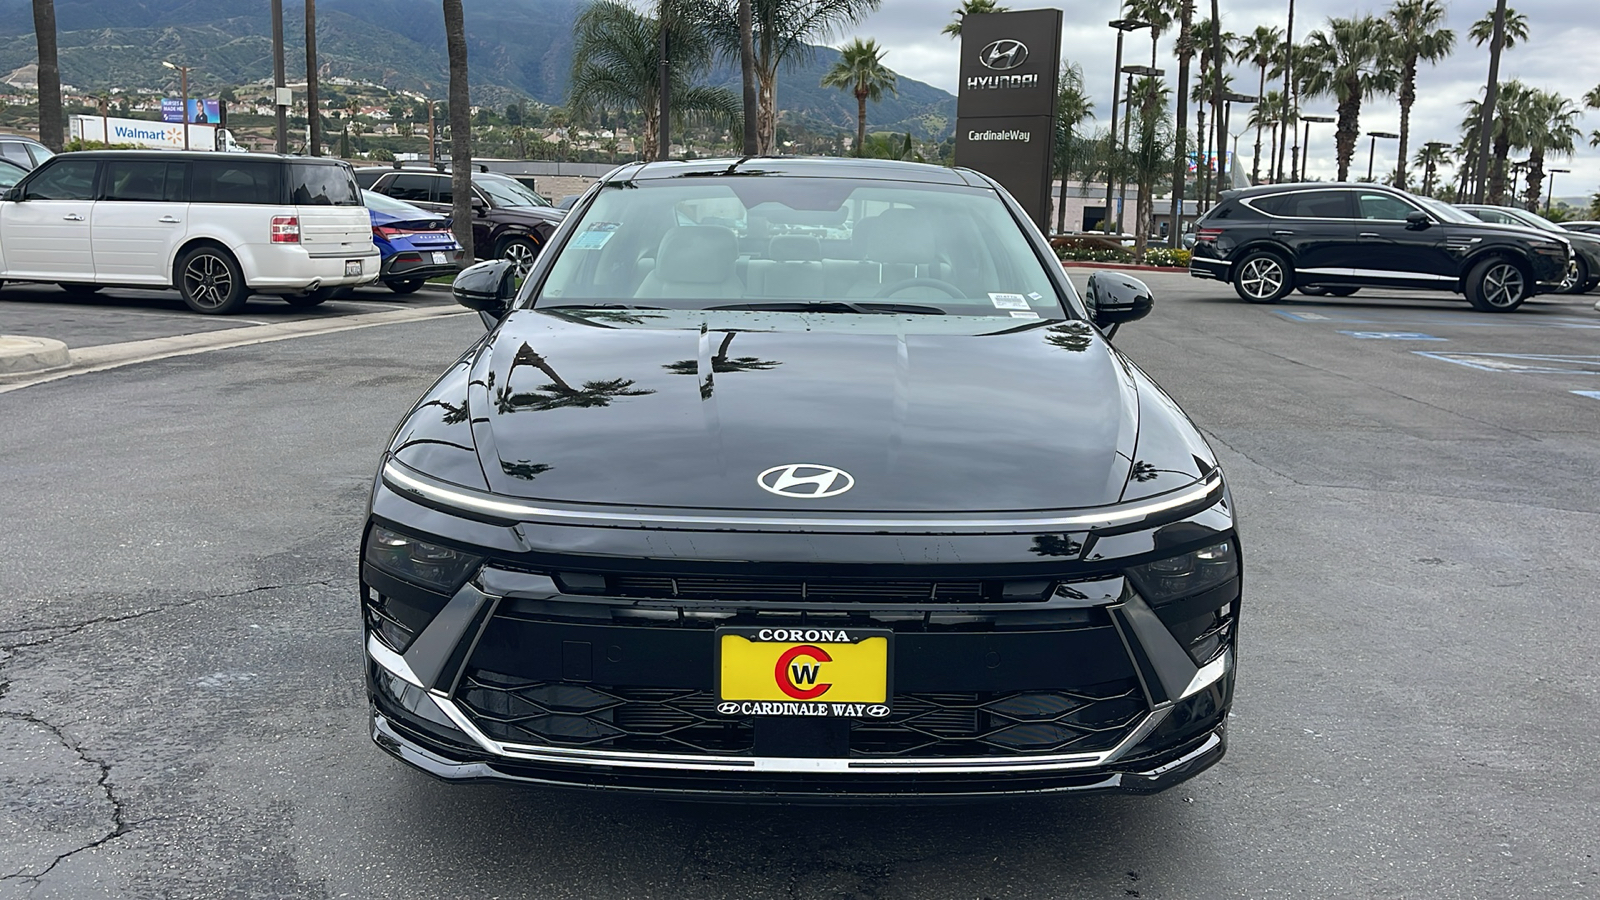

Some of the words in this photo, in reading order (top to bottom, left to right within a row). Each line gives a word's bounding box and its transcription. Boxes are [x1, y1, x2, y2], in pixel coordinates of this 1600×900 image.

[967, 74, 1038, 90] HYUNDAI
[115, 126, 166, 141] Walmart
[968, 129, 1030, 143] CardinaleWay
[758, 629, 851, 642] CORONA
[741, 702, 829, 716] CARDINALE
[832, 704, 866, 717] WAY
